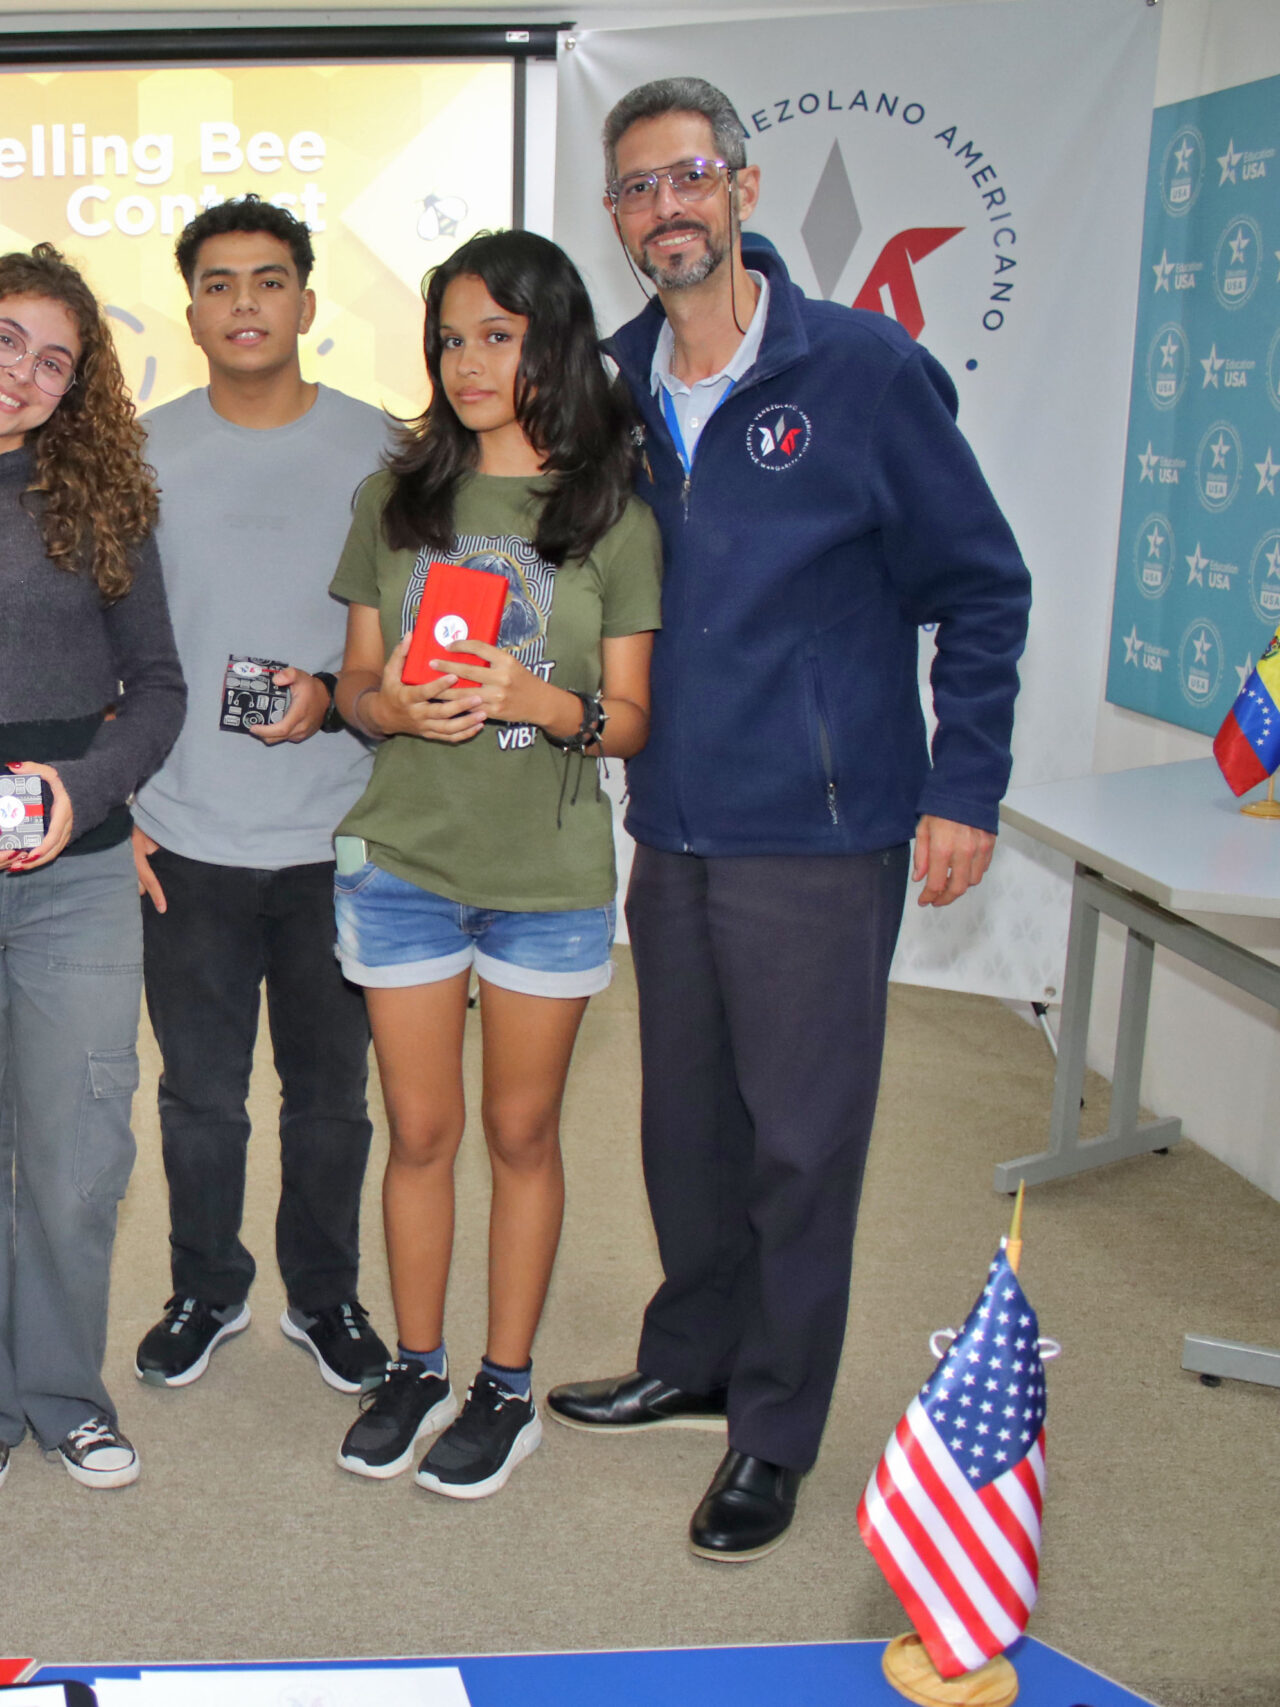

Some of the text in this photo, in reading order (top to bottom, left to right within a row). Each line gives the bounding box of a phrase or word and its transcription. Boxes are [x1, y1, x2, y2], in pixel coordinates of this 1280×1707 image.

[199, 122, 327, 173] Bee
[1242, 161, 1266, 181] USA
[66, 182, 327, 237] Contst
[934, 125, 1018, 332] AMERICANO
[1174, 273, 1196, 290] USA
[1226, 279, 1244, 292] USA
[1224, 371, 1247, 387] USA
[1158, 468, 1179, 485] USA
[1208, 483, 1225, 495] USA
[1208, 572, 1231, 591] USA
[1142, 654, 1163, 672] USA
[1190, 678, 1206, 691] USA
